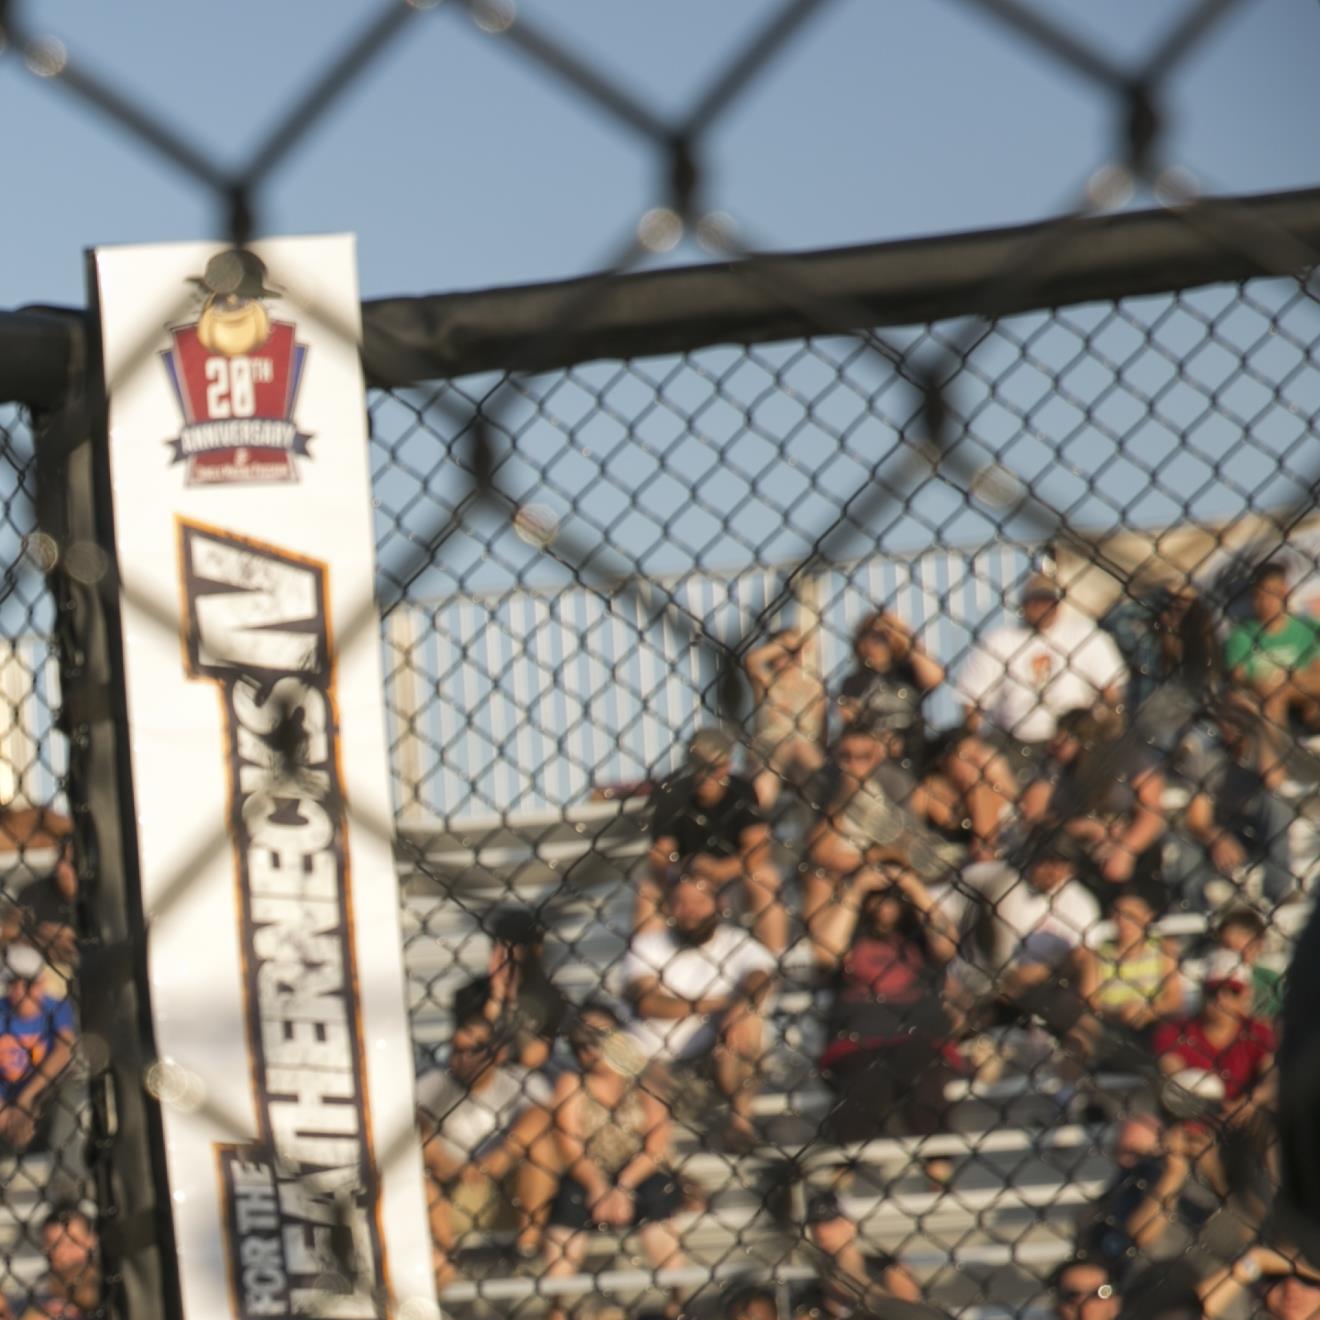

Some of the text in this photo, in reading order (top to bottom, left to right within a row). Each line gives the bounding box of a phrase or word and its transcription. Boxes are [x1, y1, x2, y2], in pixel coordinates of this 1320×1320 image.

[181, 419, 297, 455] ANNIVERSARY
[232, 676, 378, 1320] LEATHERNECKS
[229, 1158, 287, 1316] FOR THE
